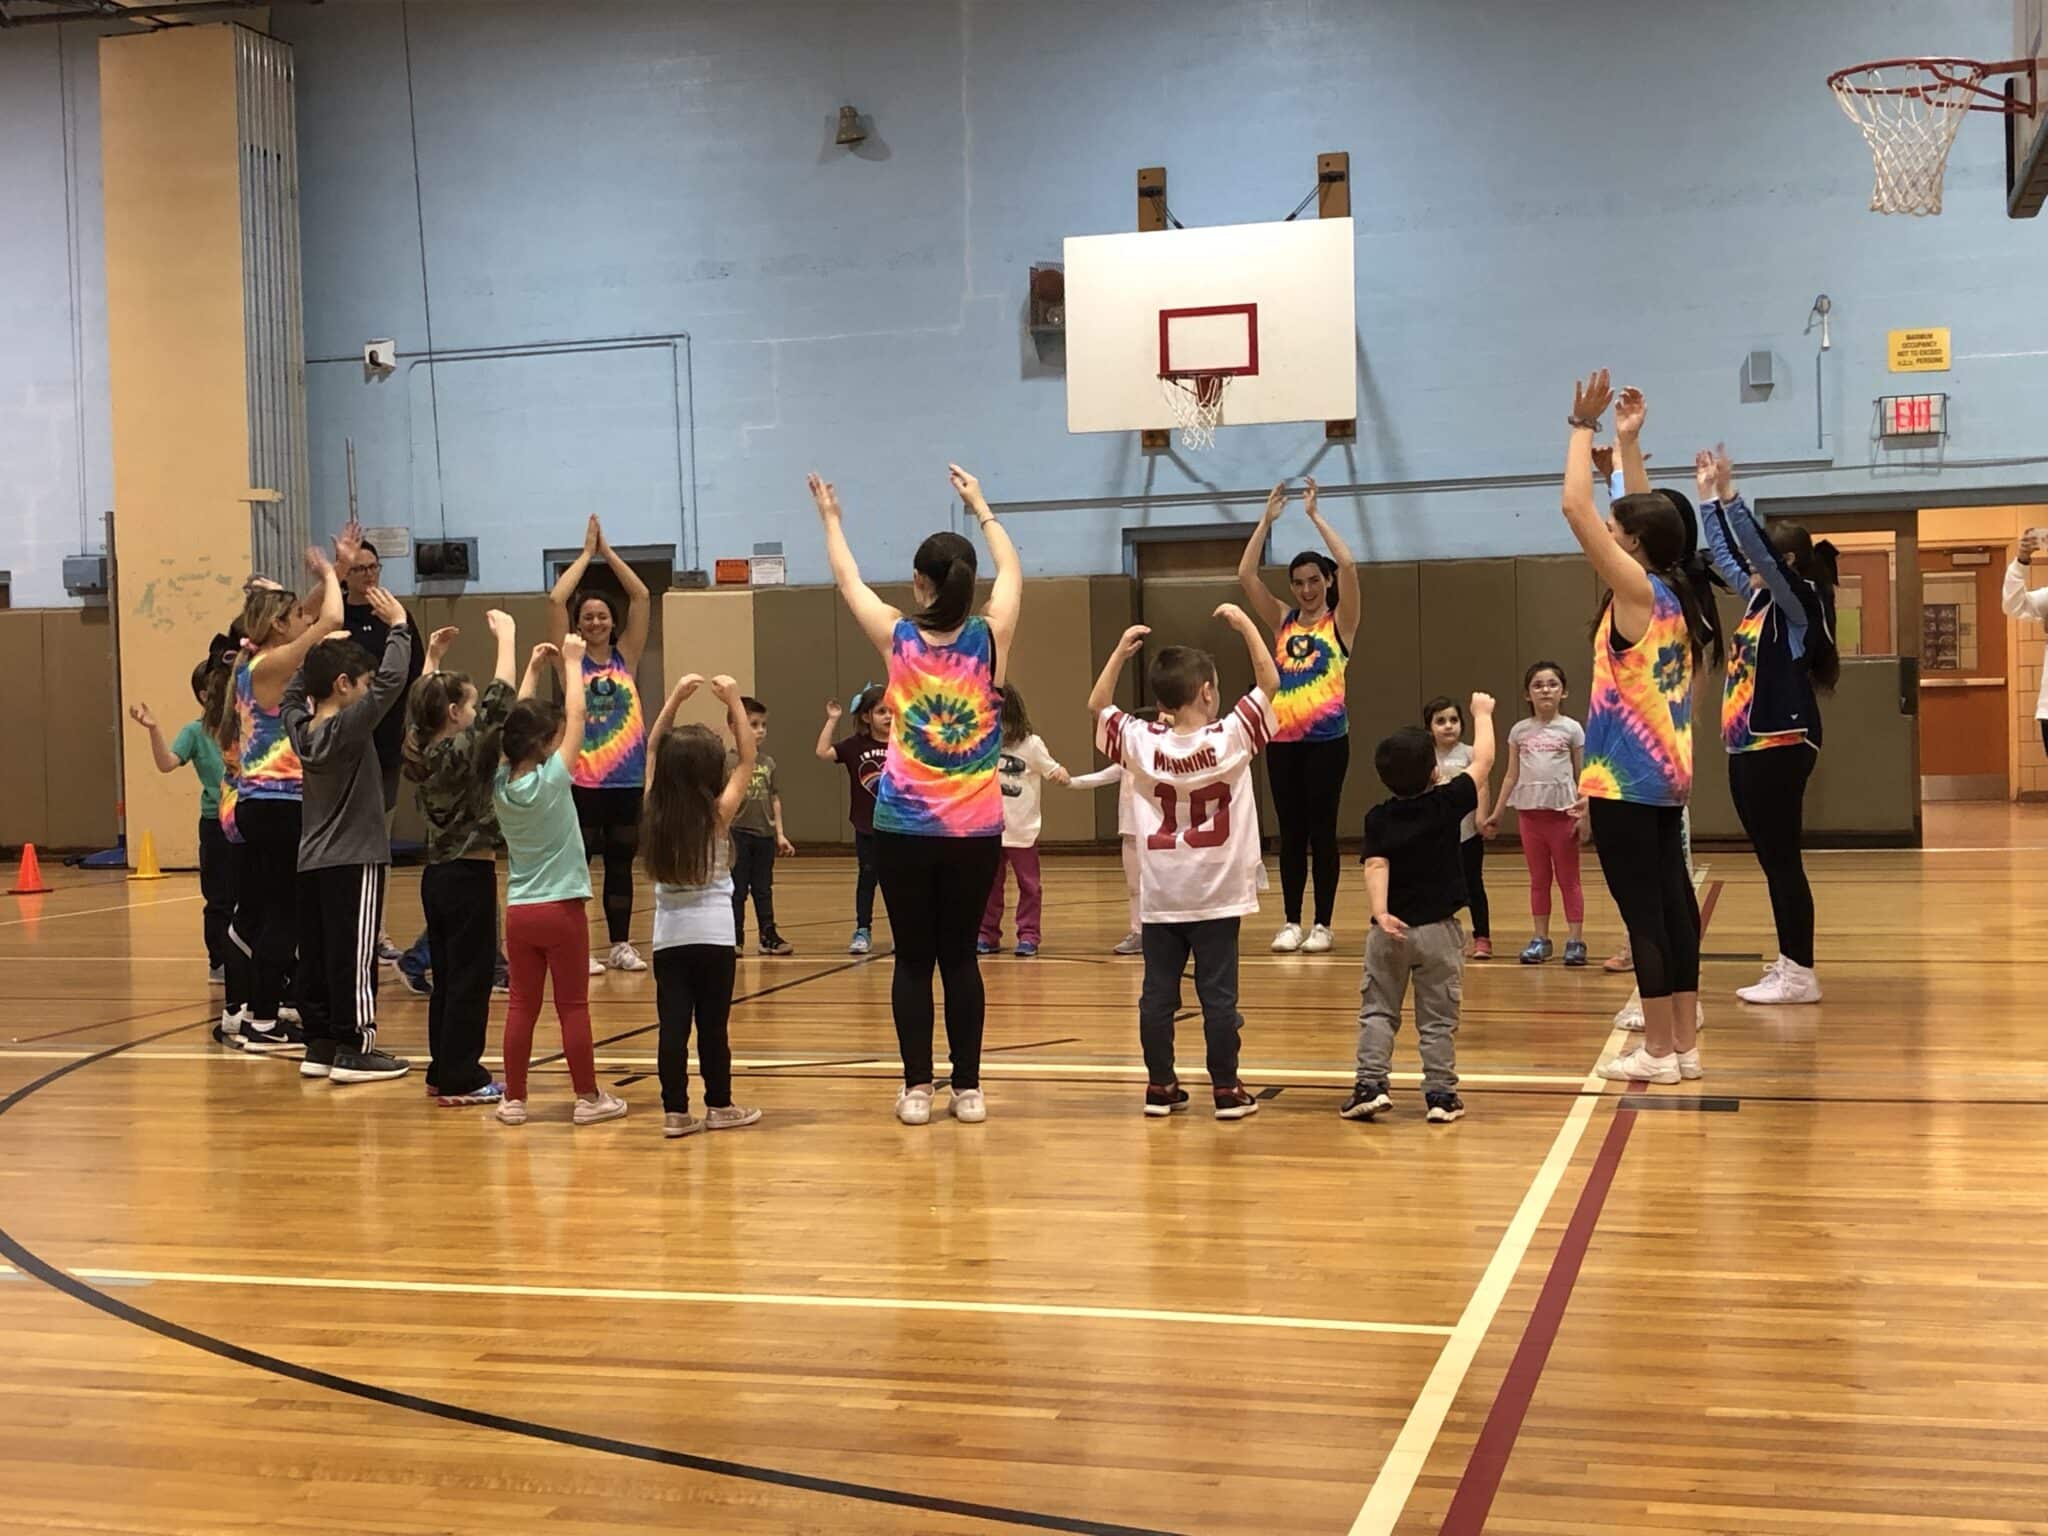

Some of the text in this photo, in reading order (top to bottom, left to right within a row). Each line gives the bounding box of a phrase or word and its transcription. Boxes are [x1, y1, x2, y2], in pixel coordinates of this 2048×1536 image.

[1895, 400, 1931, 428] EXIT
[1153, 747, 1217, 774] MANNING
[1147, 780, 1232, 850] 10
